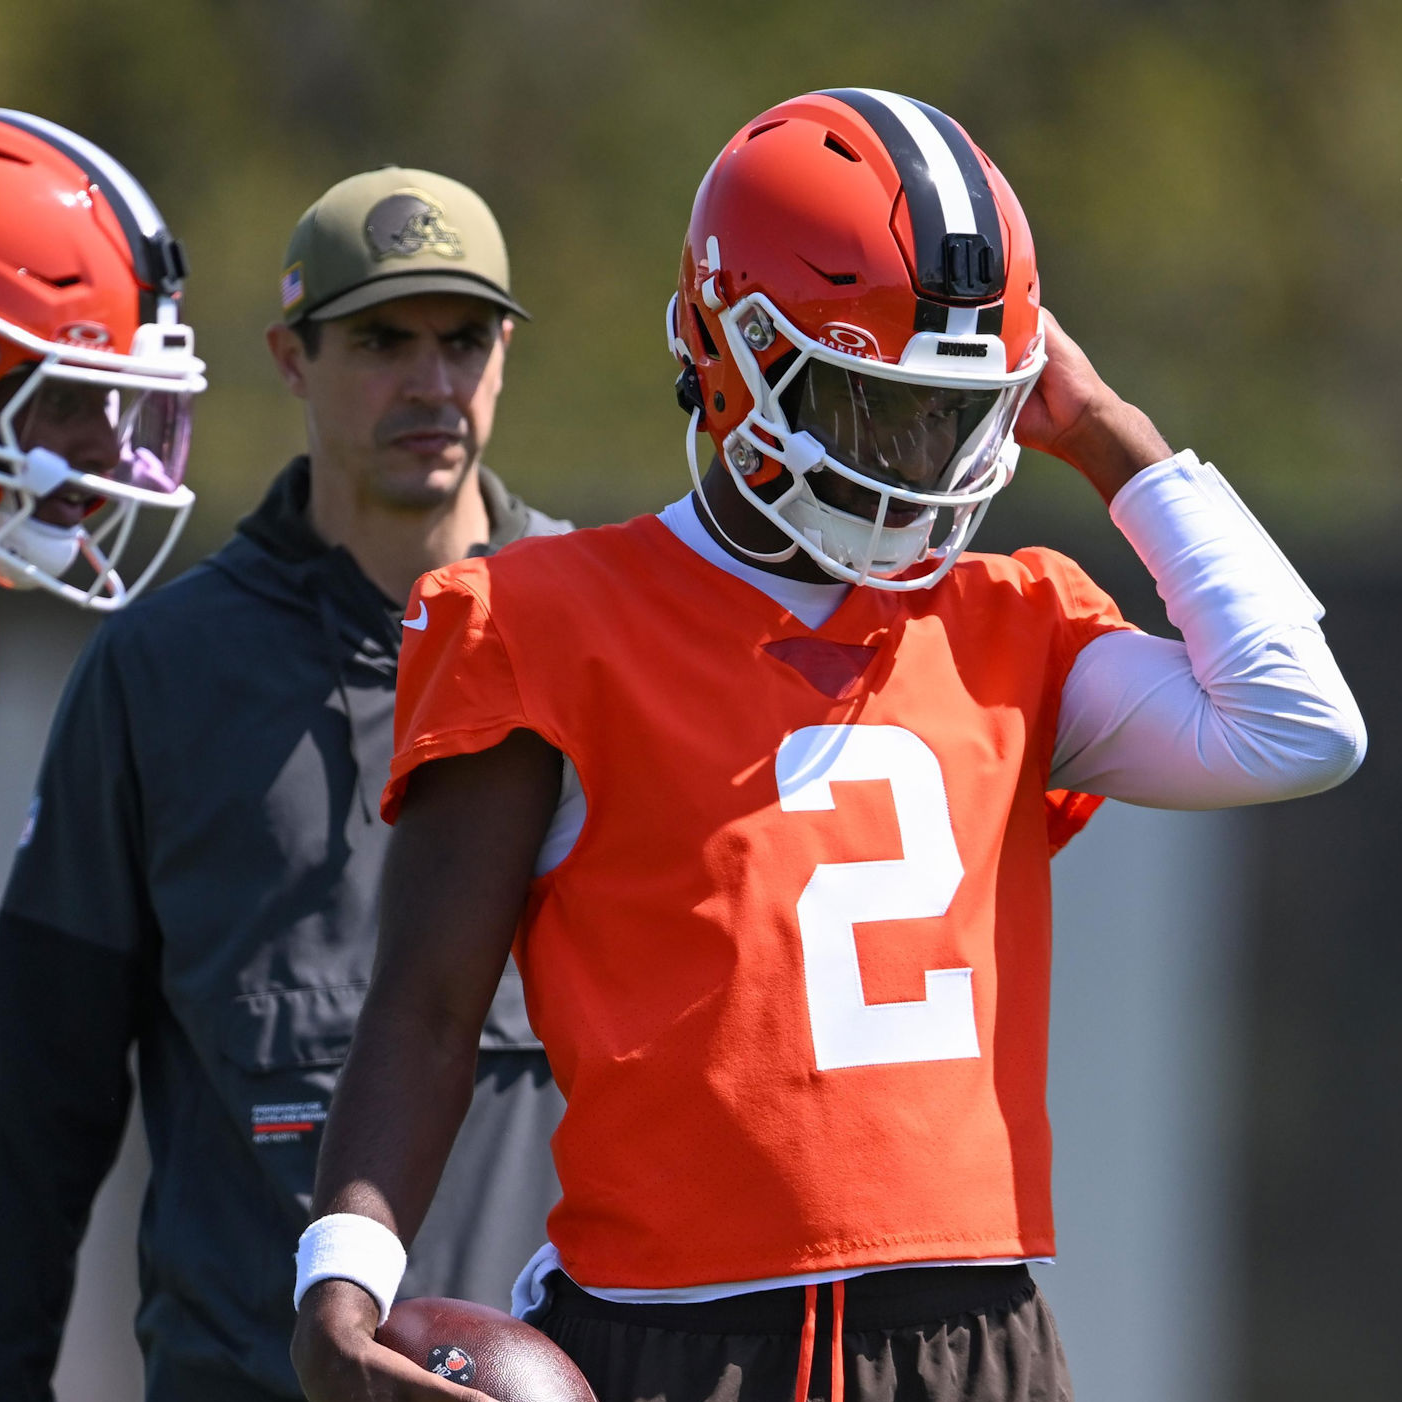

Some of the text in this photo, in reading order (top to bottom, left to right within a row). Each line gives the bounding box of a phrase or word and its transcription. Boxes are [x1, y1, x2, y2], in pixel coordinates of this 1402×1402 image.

[819, 336, 872, 359] OAKLEY
[936, 340, 988, 357] BROWNS
[775, 724, 981, 1071] 2
